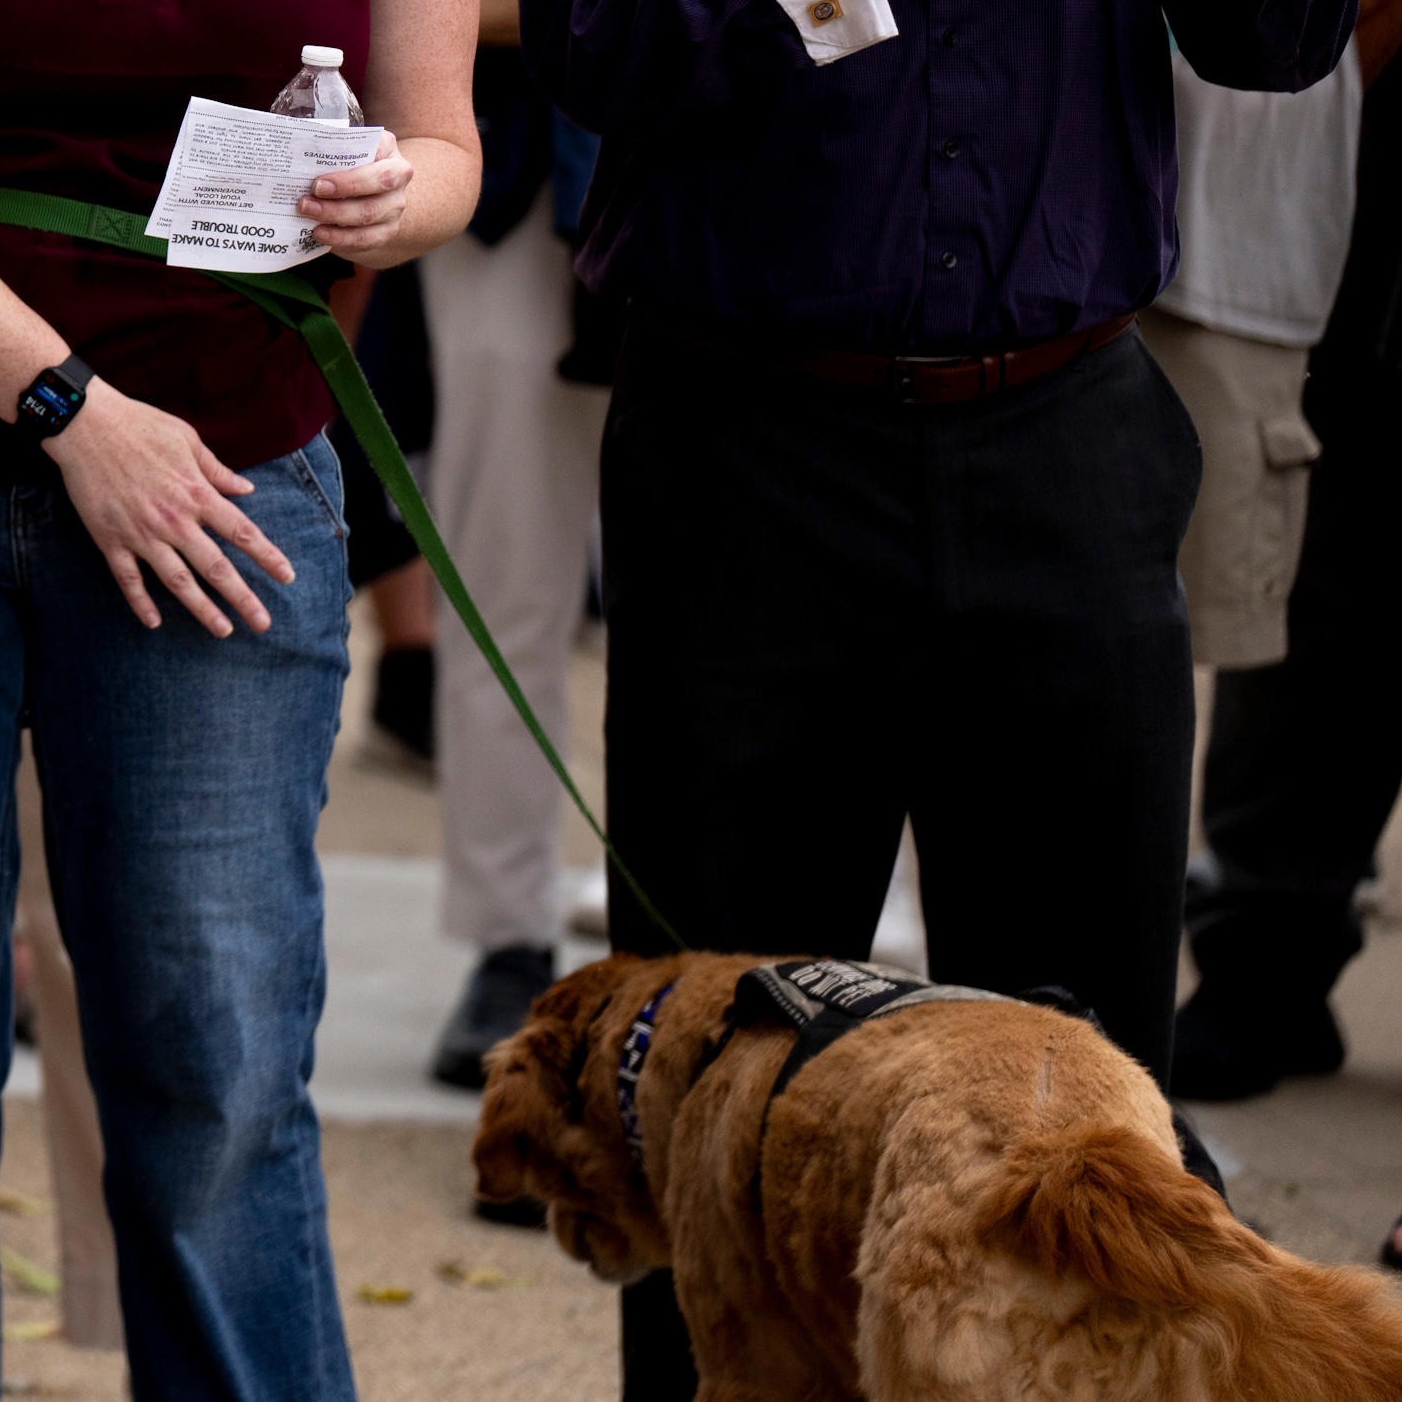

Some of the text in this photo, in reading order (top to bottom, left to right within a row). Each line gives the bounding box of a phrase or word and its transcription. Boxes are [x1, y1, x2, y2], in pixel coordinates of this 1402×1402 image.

[193, 186, 246, 194] GOVERNMENT
[192, 221, 275, 238] GOOD TROUBLE
[172, 234, 288, 254] SOME WAYS TO MAKE
[789, 964, 823, 987] DO
